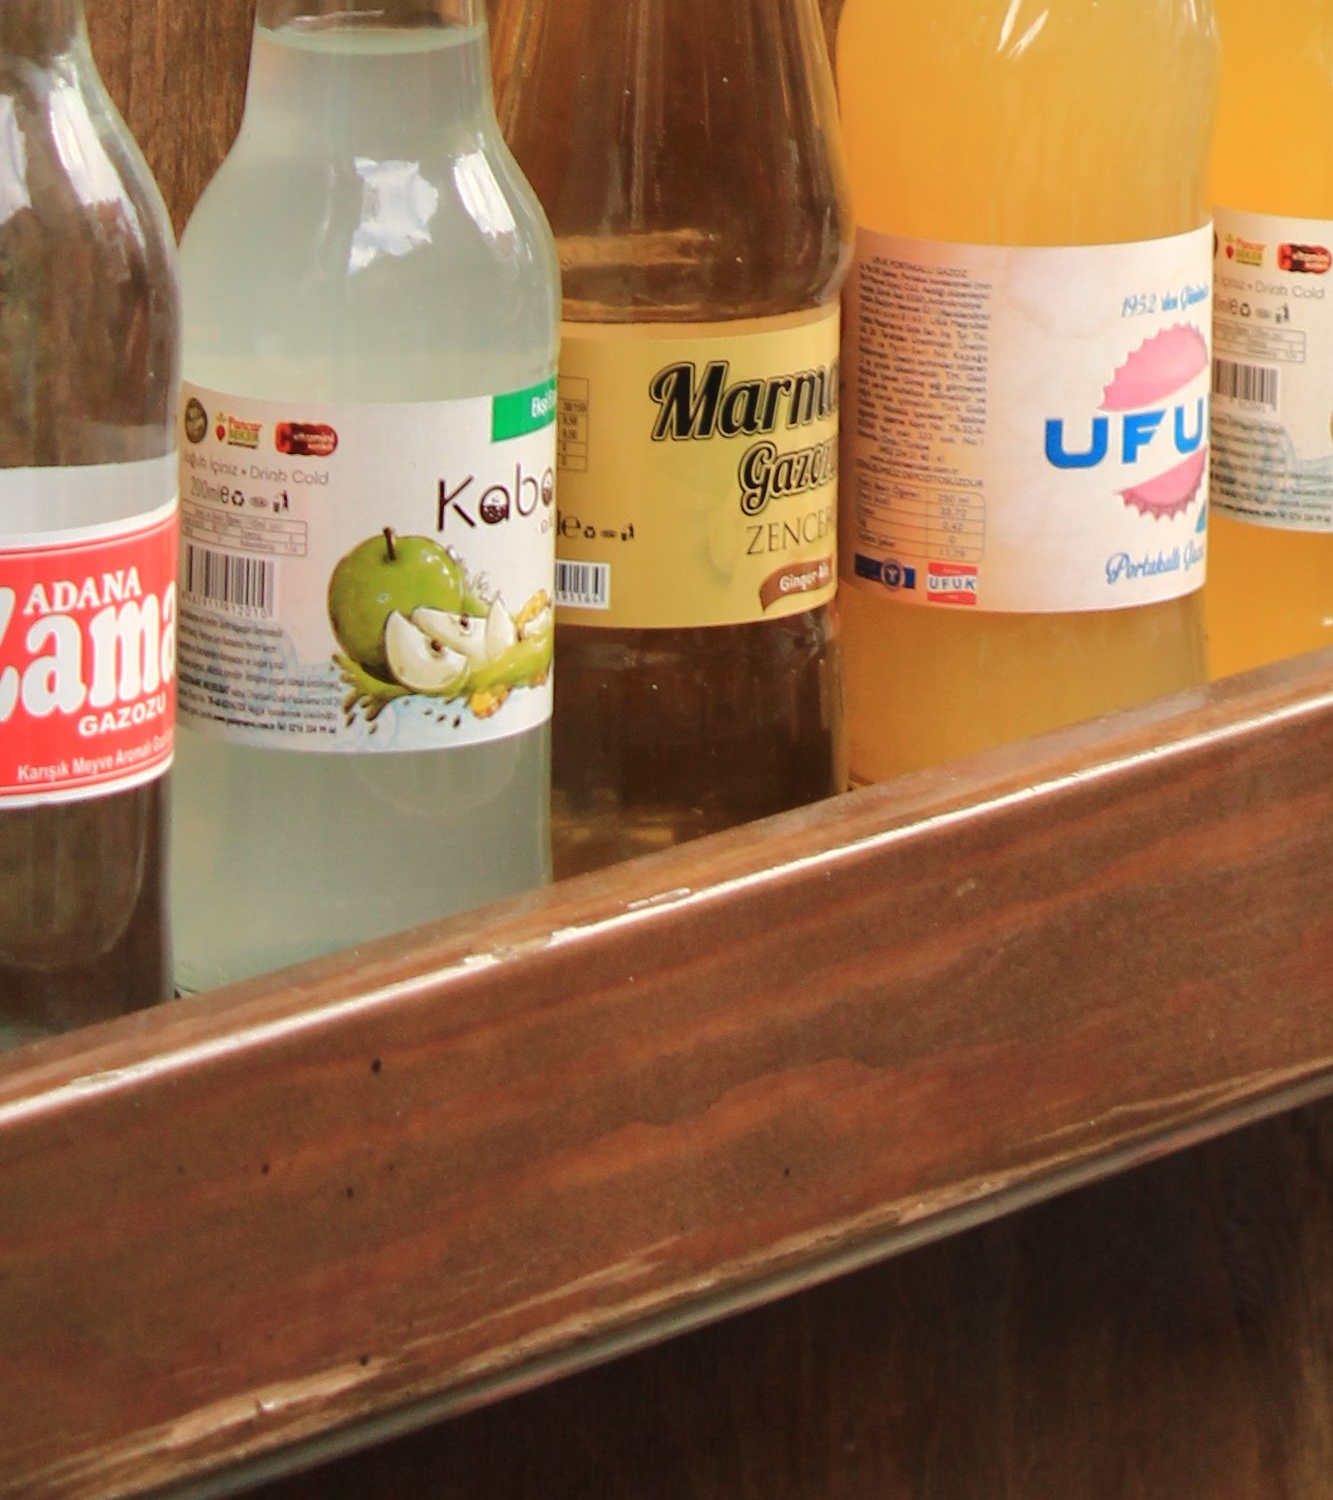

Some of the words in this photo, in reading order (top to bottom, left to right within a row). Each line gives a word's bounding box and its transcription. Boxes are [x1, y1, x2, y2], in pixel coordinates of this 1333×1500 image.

[1044, 397, 1211, 470] UFU
[23, 565, 142, 616] ADANA
[928, 576, 977, 592] UFUK
[78, 692, 167, 738] GAZOZU
[17, 760, 69, 783] Karışık
[71, 751, 114, 778] Meyve
